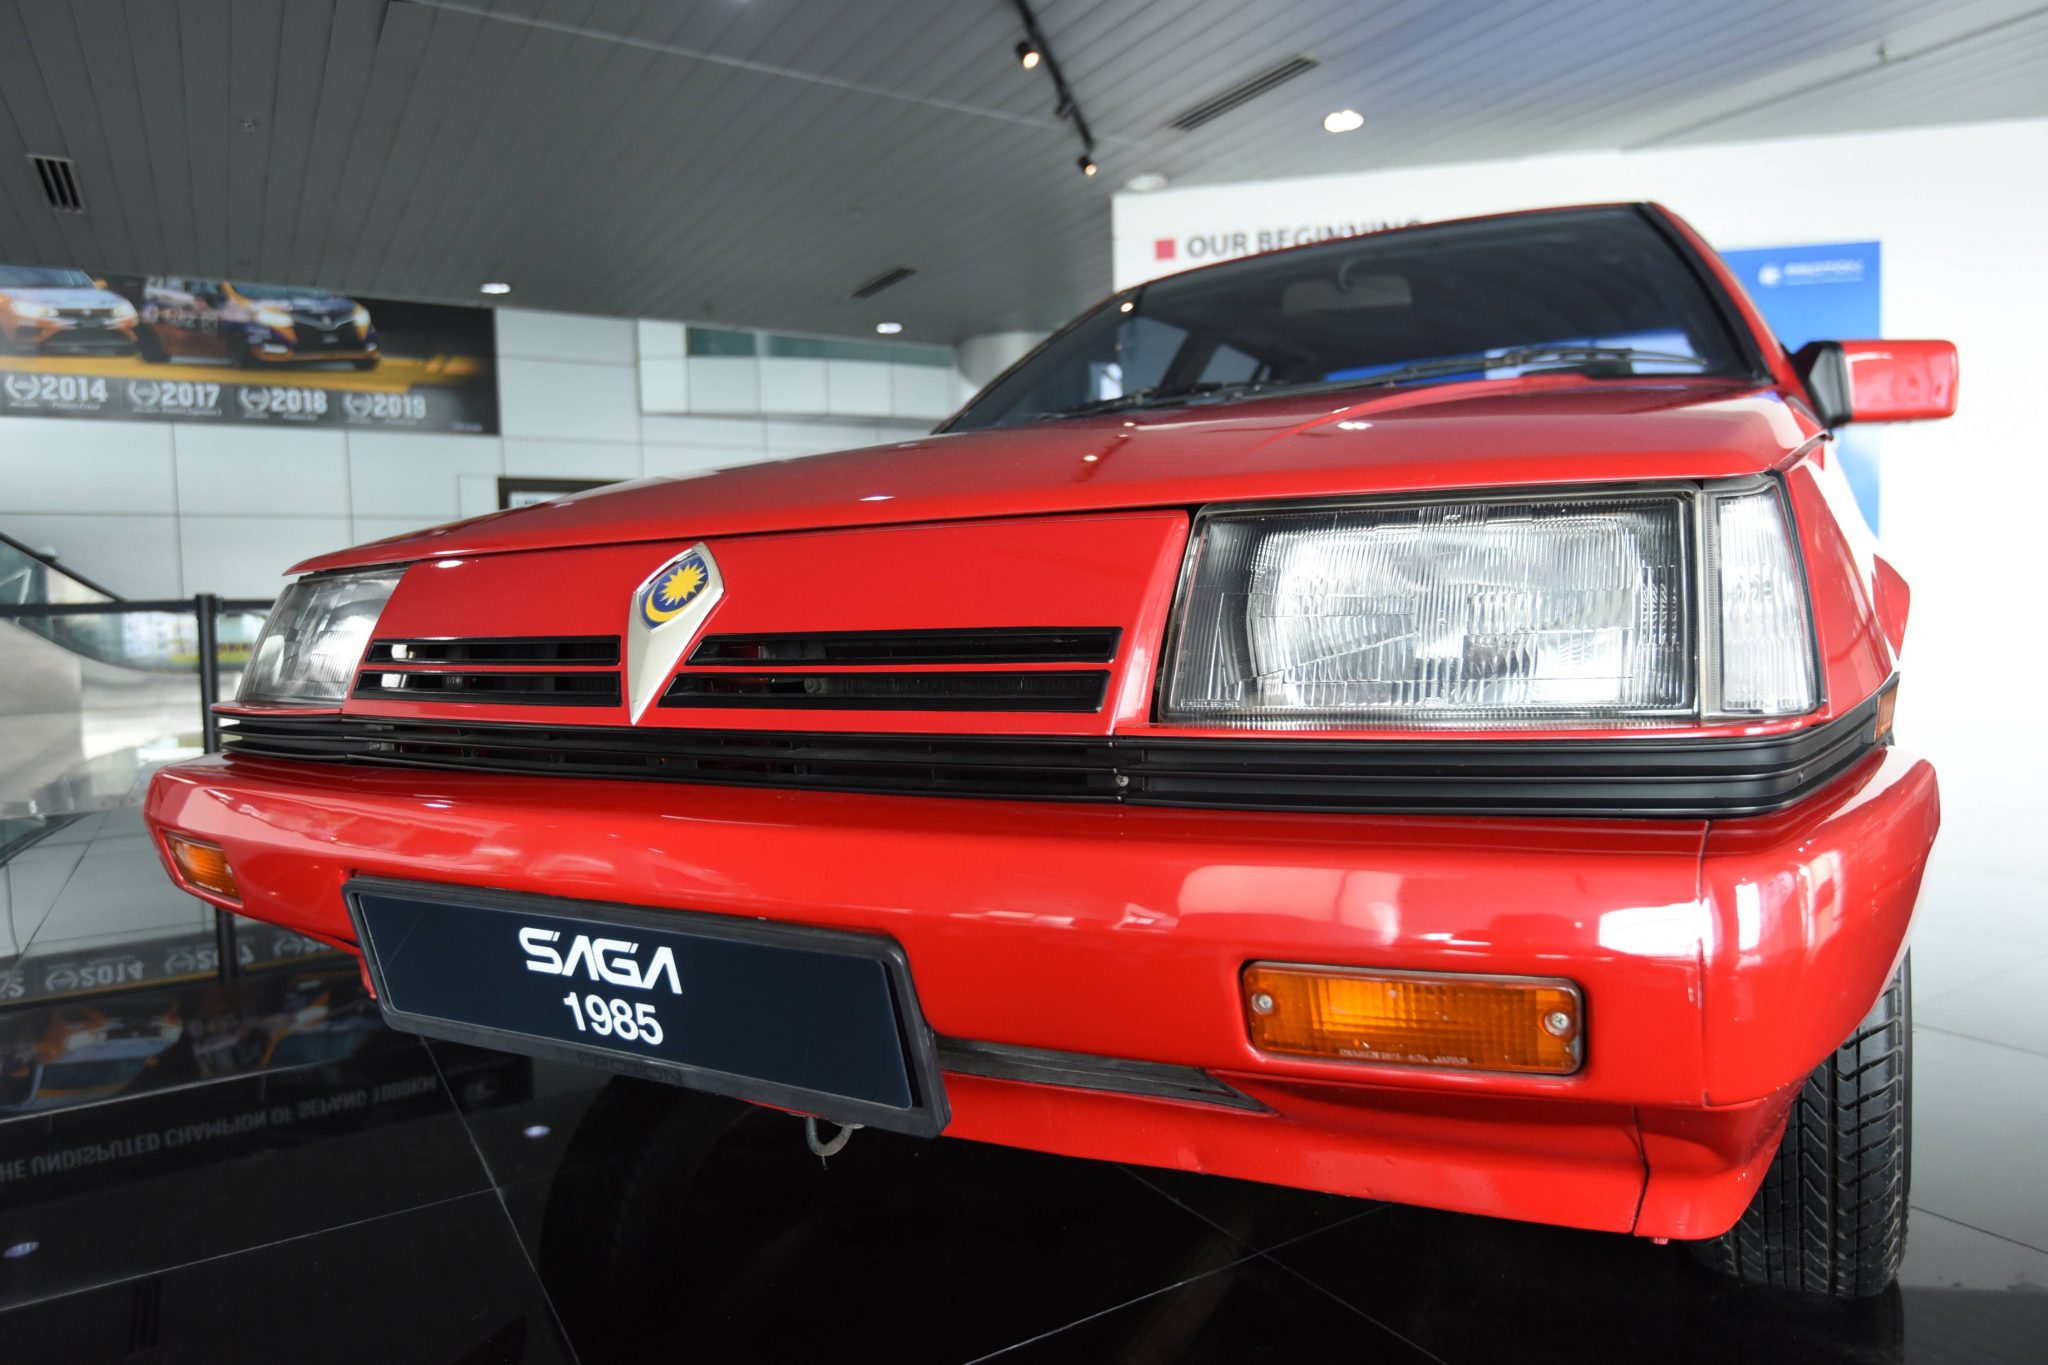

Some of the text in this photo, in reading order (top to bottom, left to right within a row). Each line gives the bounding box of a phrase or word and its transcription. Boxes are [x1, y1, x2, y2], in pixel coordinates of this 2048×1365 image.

[1186, 233, 1248, 259] OUR
[41, 375, 108, 403] 2014
[161, 381, 221, 409] 2017
[269, 387, 328, 414] 2018
[518, 926, 682, 995] SAGA
[563, 991, 664, 1046] 1985
